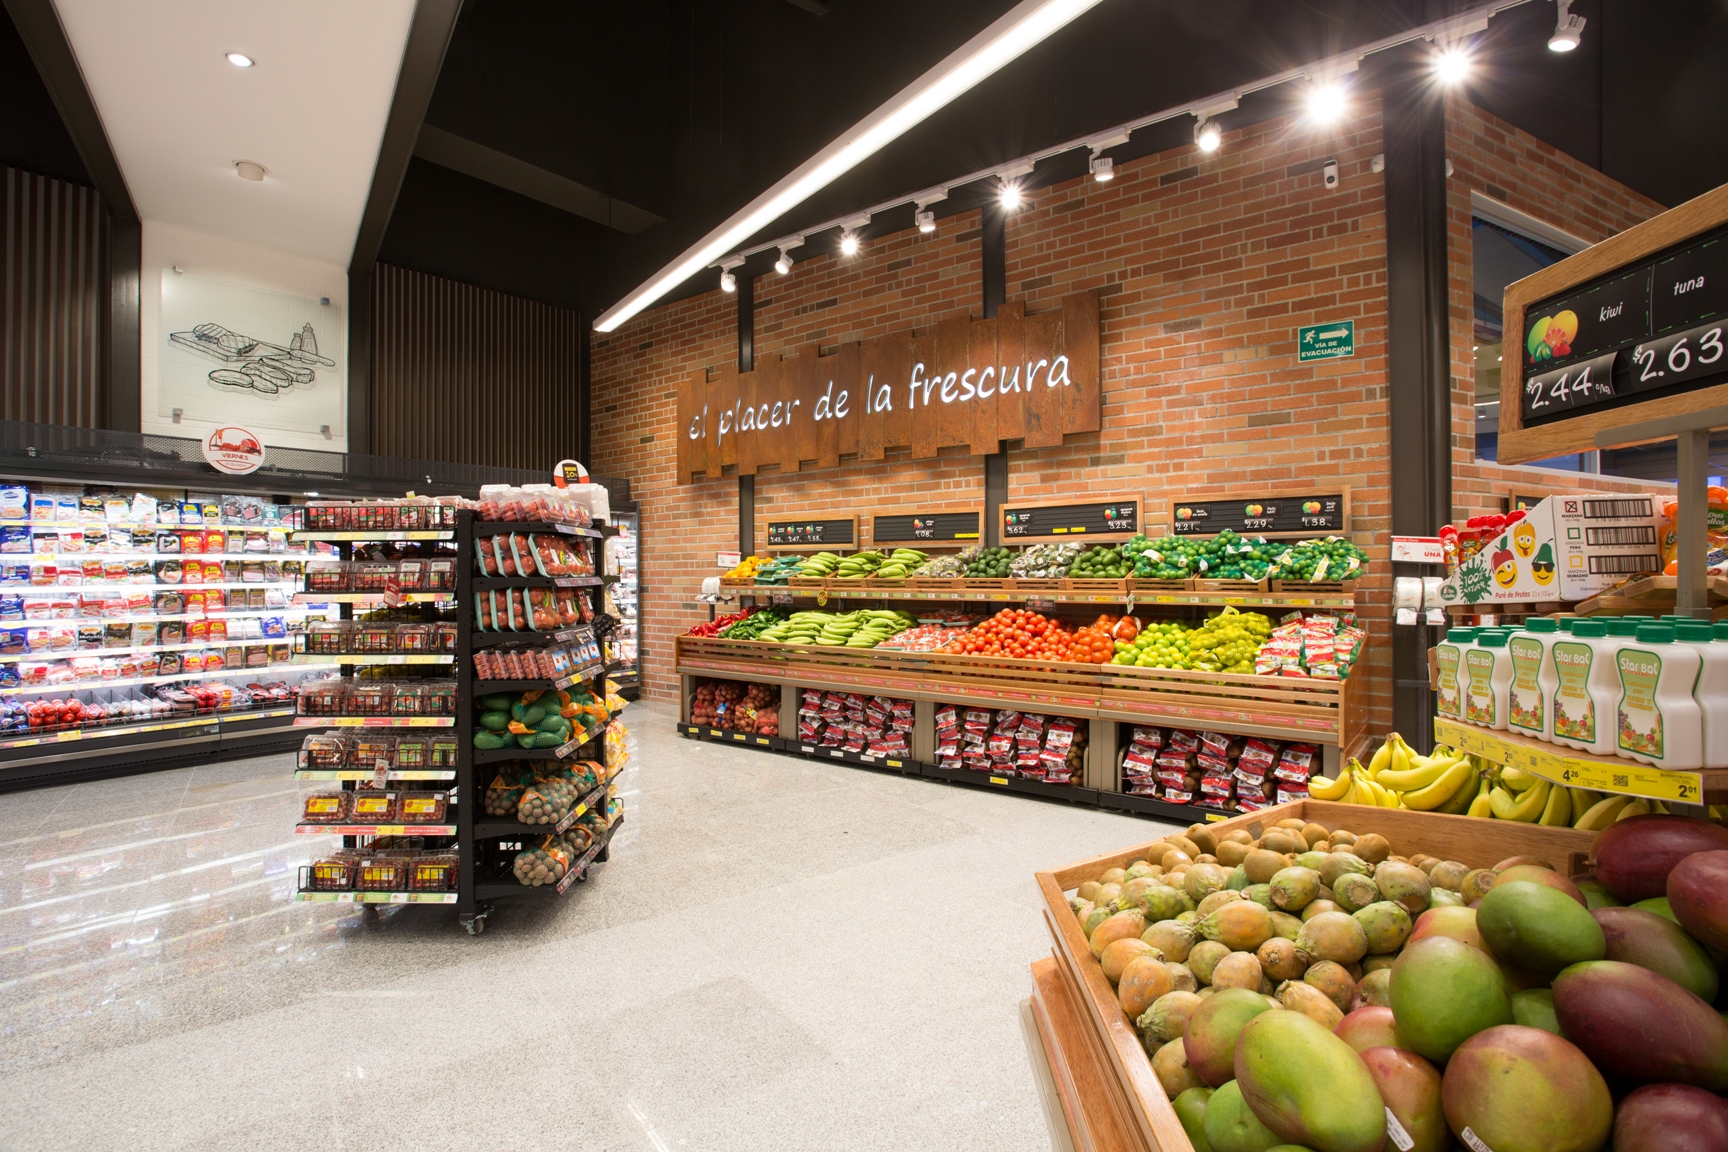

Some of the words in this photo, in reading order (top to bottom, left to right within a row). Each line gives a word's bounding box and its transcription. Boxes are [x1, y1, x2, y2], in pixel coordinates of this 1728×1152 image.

[1674, 276, 1705, 295] tuna
[1599, 302, 1623, 322] kiwi
[1302, 346, 1352, 357] EVACUACIÓN
[1632, 327, 1724, 382] $2.63
[688, 402, 707, 440] el
[717, 396, 801, 448] placer
[813, 379, 850, 422] de
[865, 373, 893, 414] la
[908, 354, 1071, 410] frescura
[1526, 366, 1592, 410] $2.44
